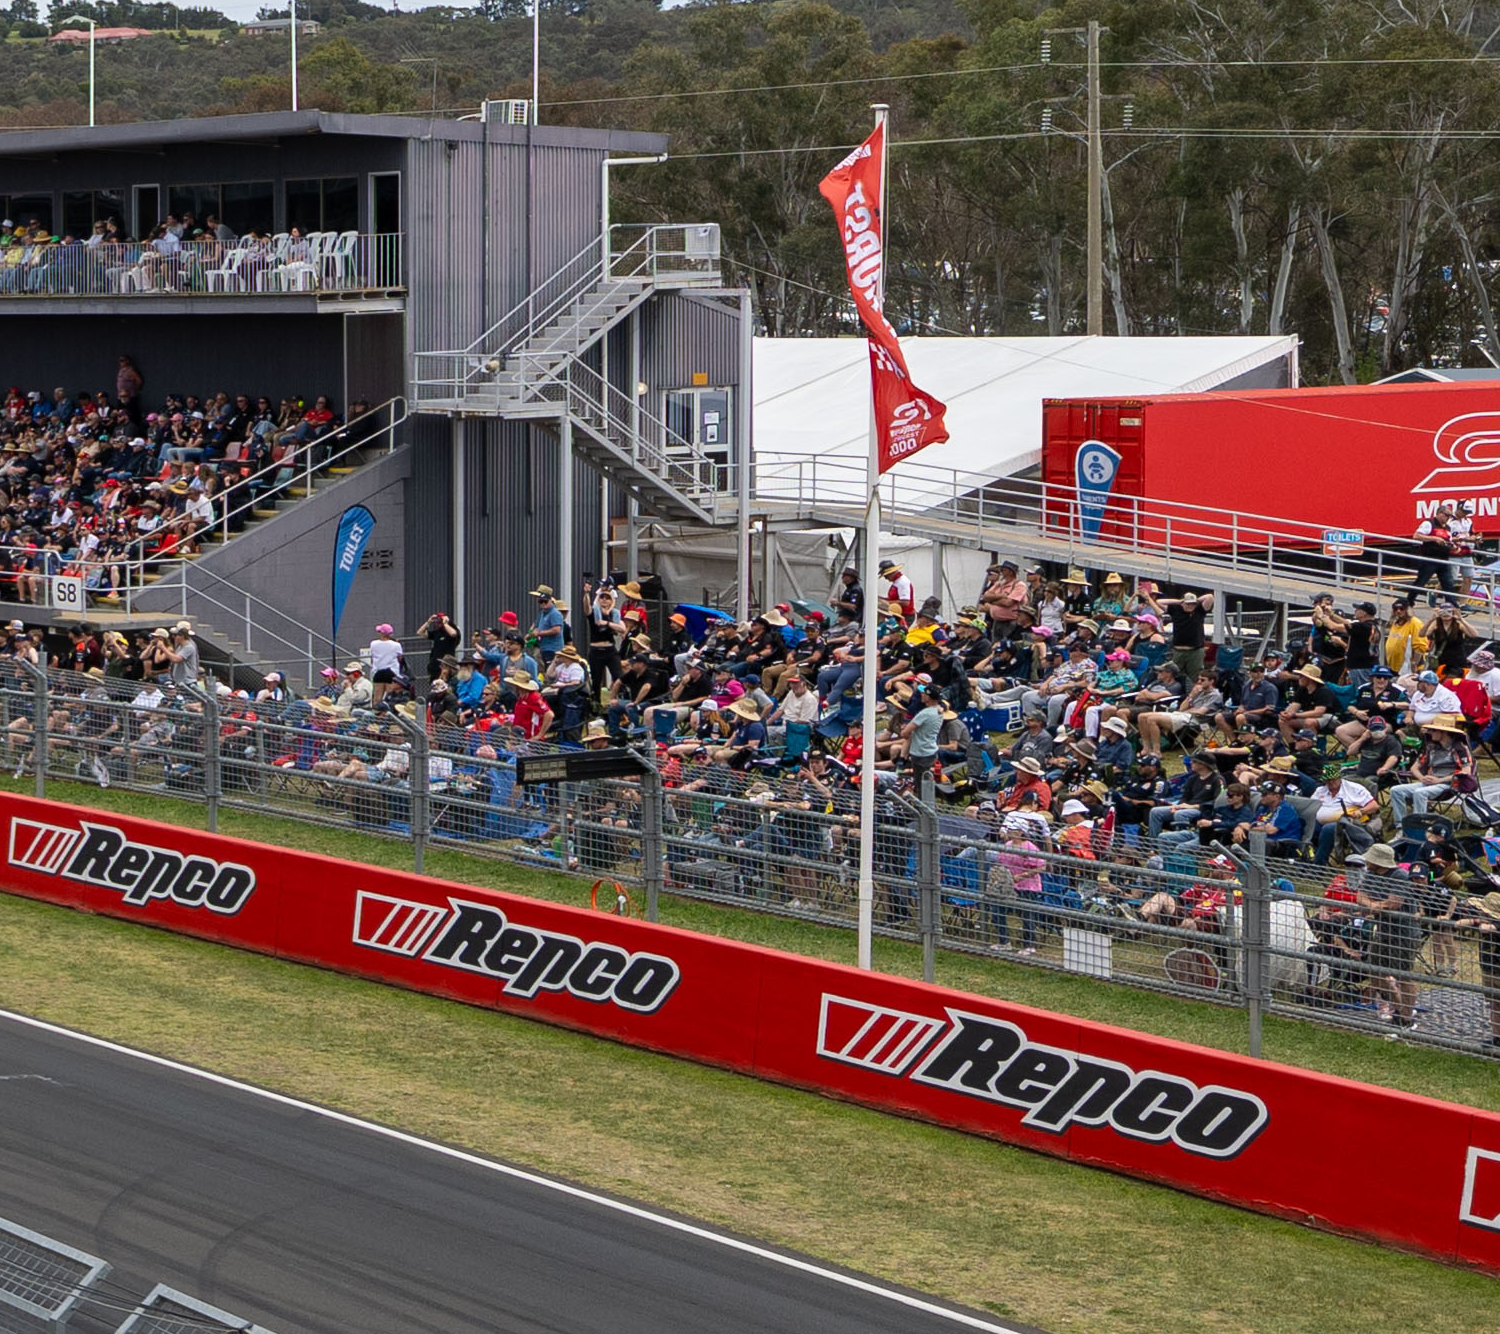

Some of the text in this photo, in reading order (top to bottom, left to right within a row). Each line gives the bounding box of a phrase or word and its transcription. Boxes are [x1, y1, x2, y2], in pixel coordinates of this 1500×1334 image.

[339, 521, 365, 573] TOILET
[1326, 532, 1362, 544] TOILETS
[57, 581, 79, 603] S8
[63, 821, 257, 916] Repco
[422, 895, 681, 1015] Repco
[911, 1006, 1270, 1159] Repco
